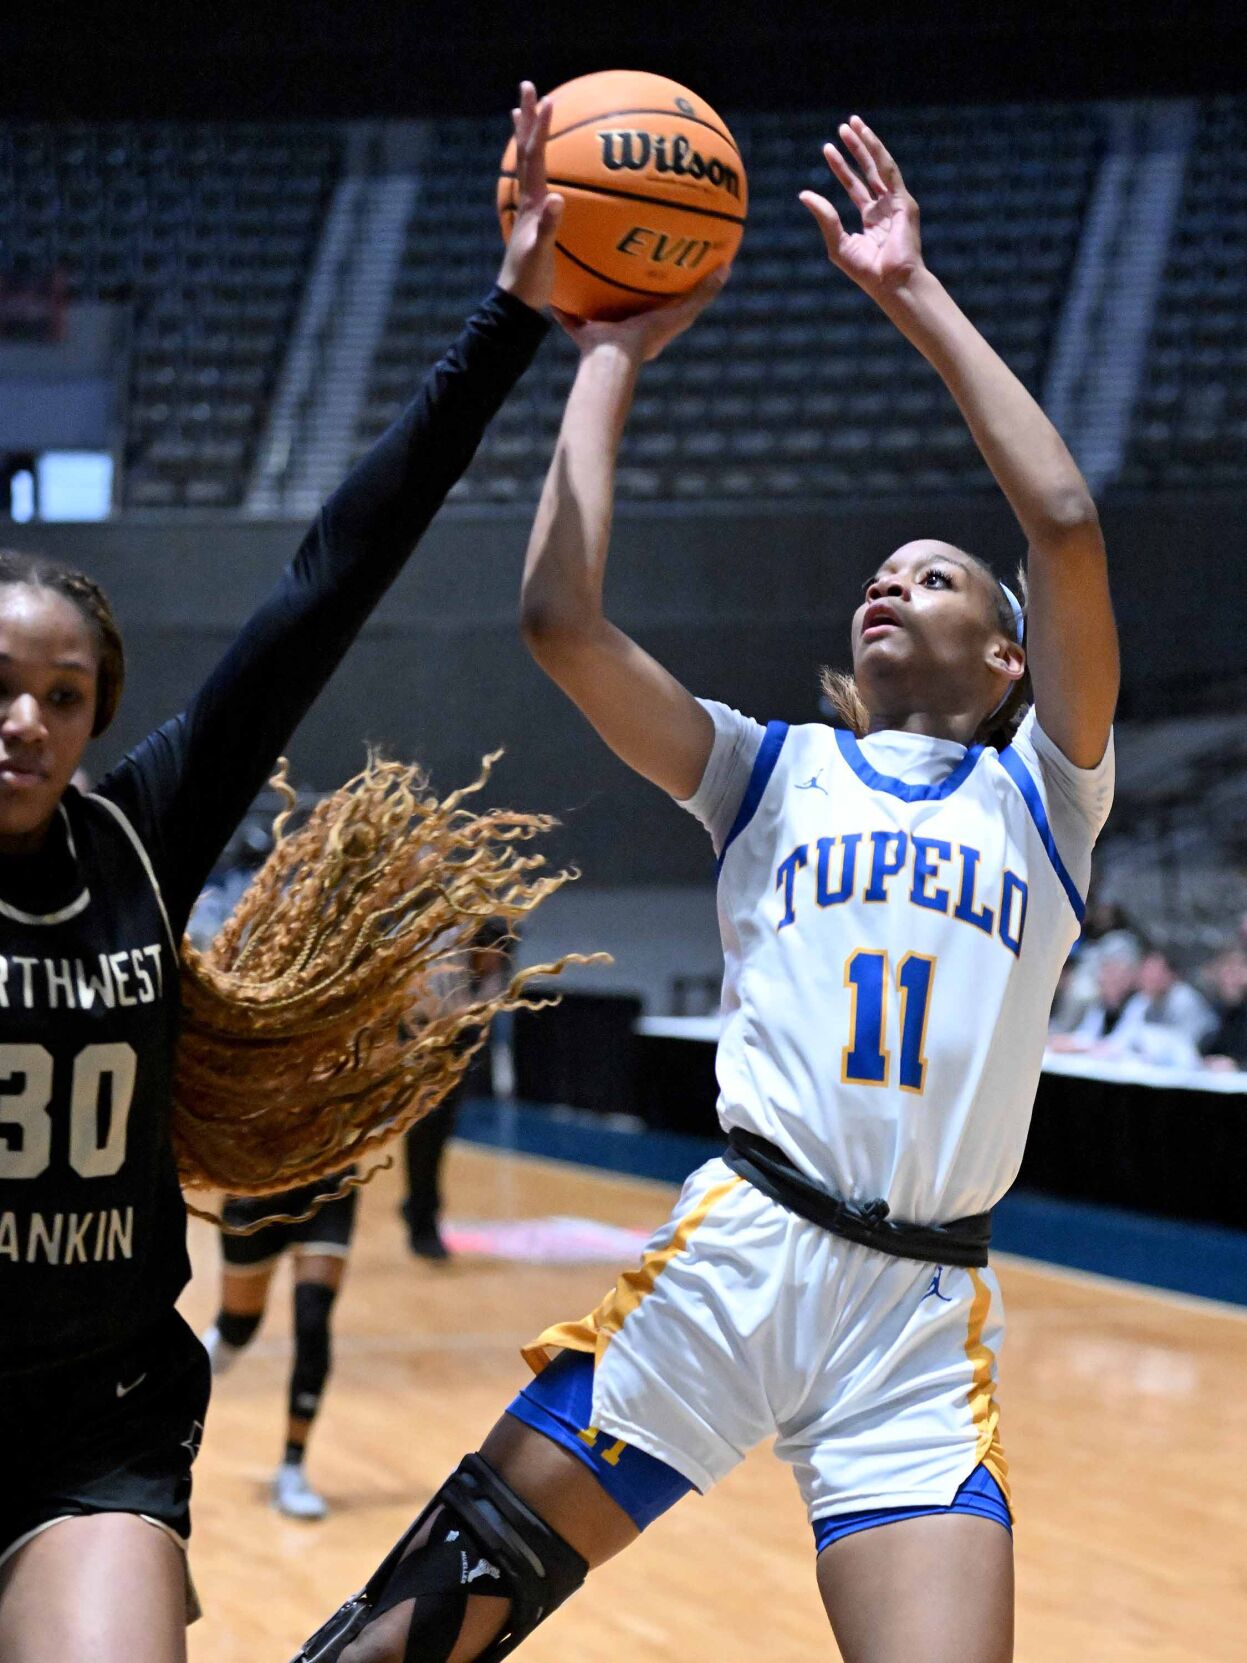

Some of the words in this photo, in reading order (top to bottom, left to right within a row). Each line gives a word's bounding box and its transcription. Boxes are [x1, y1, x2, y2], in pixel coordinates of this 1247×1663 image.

[597, 131, 740, 200] Wilson
[775, 830, 1029, 960] TUPELO
[840, 946, 938, 1097] 11
[0, 1042, 138, 1179] 30
[0, 1206, 134, 1265] ANKIN
